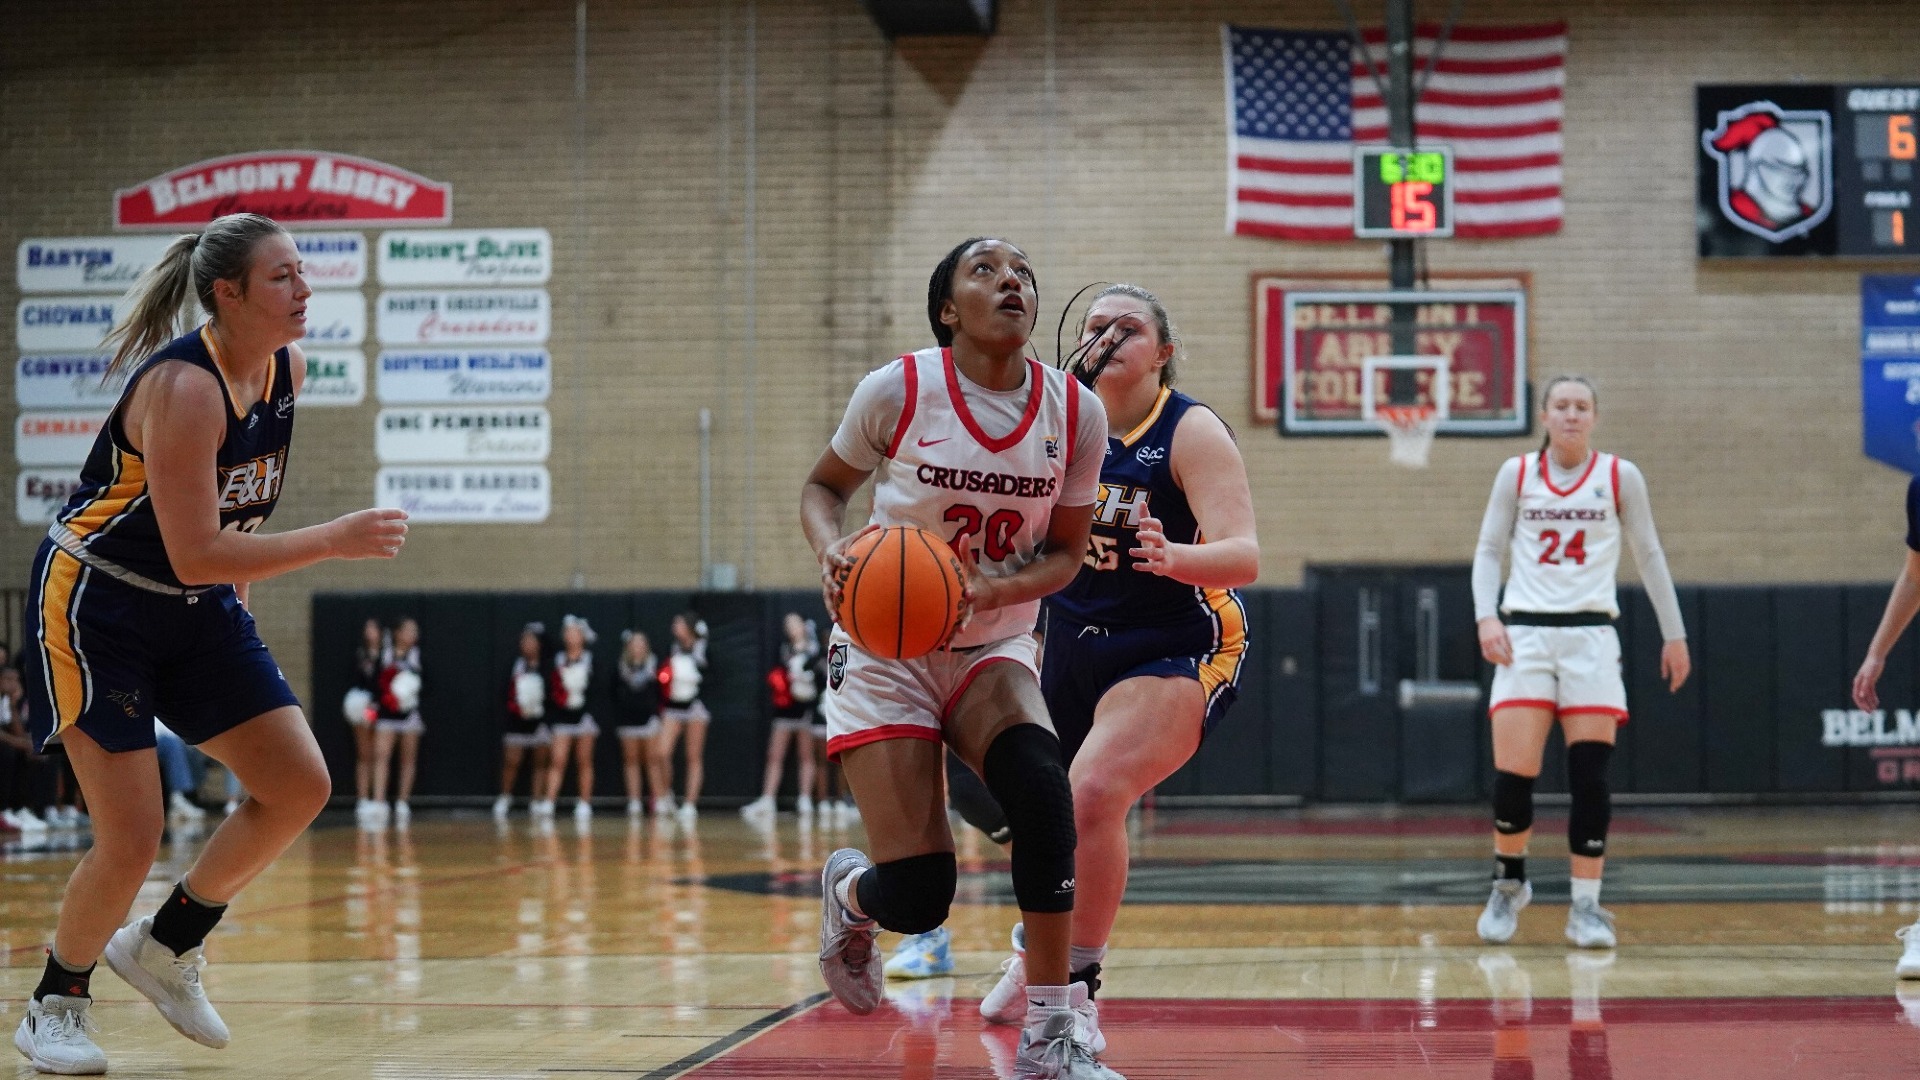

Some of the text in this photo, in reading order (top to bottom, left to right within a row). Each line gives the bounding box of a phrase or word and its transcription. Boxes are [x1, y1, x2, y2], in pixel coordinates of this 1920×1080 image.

[1888, 114, 1917, 160] 6
[150, 152, 417, 215] BELMONT ABBEY
[1390, 182, 1436, 231] 15
[916, 463, 1057, 498] CRUSADERS
[943, 504, 1025, 564] 20
[1539, 528, 1587, 565] 24
